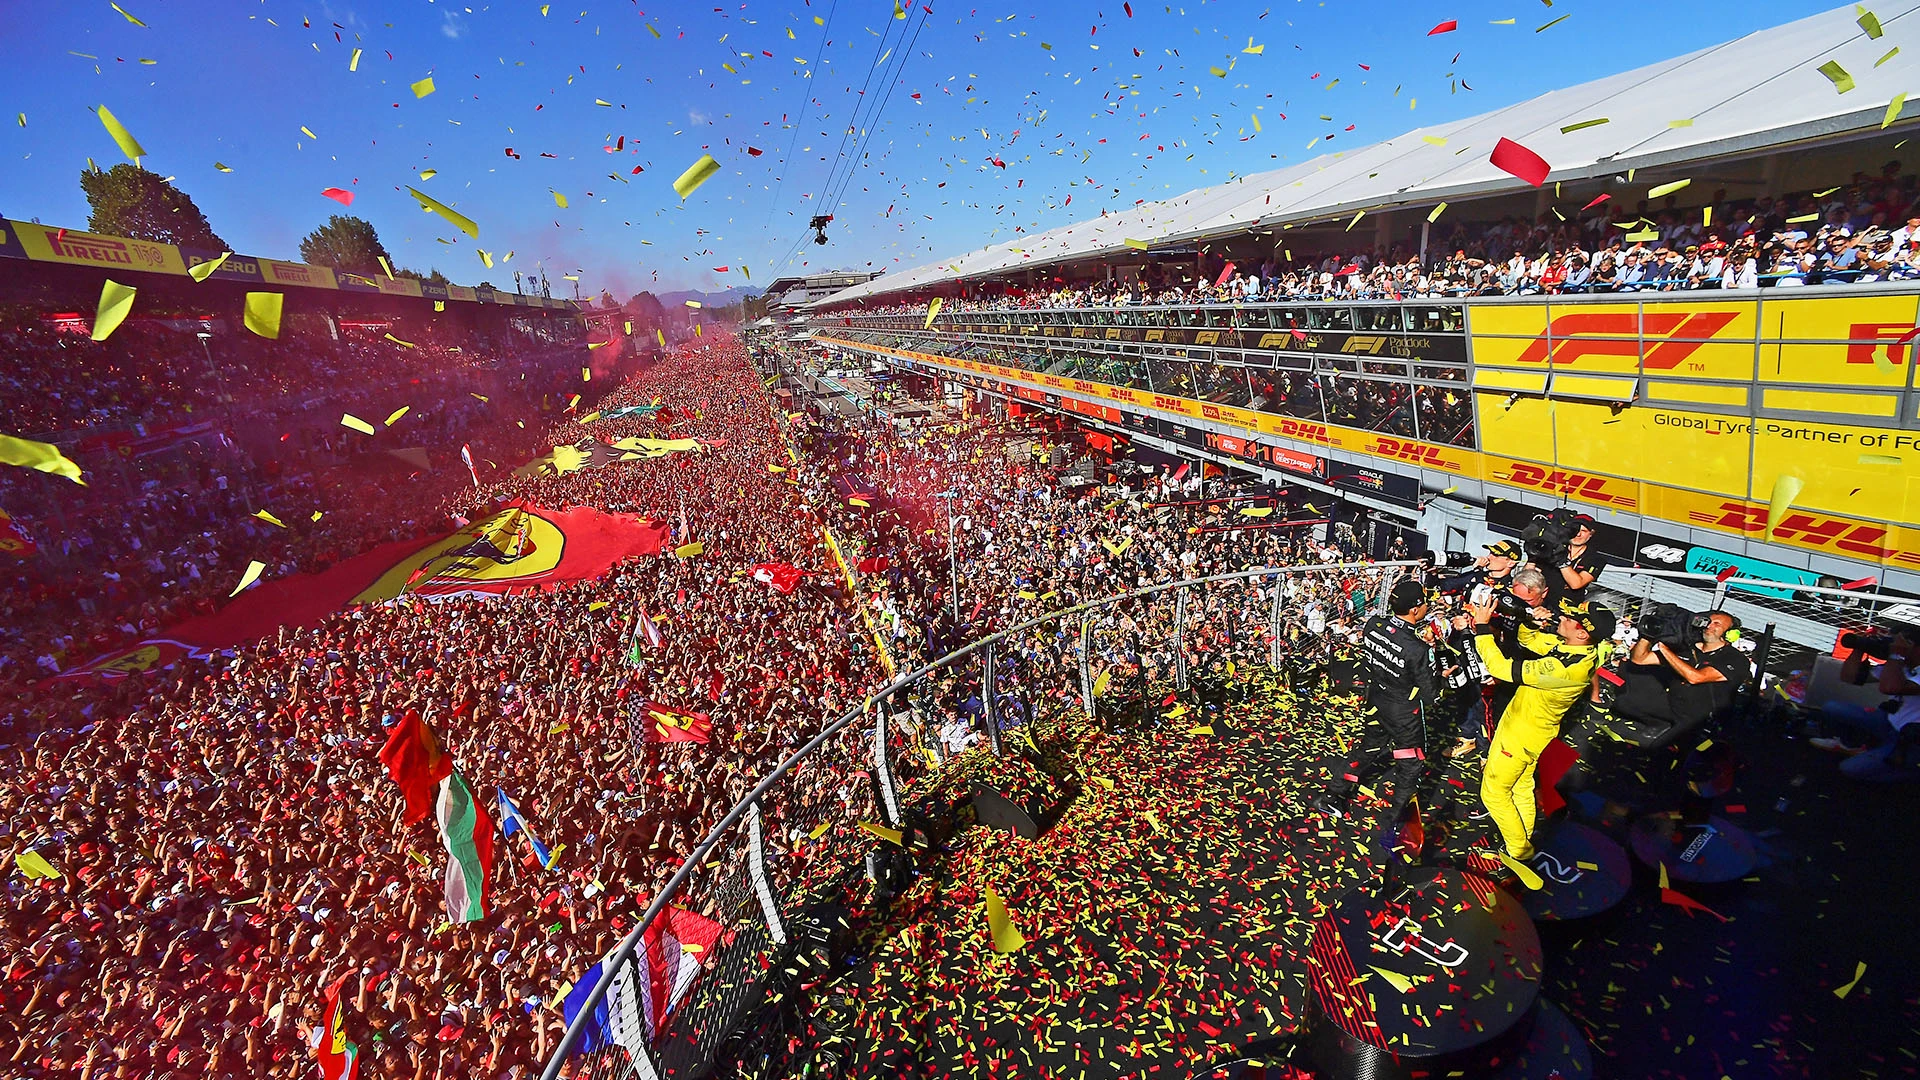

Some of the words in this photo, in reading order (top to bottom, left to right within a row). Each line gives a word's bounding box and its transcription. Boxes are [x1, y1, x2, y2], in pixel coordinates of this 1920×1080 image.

[45, 231, 132, 264] PIRELLI
[208, 258, 256, 274] ERO
[271, 263, 311, 283] PIRELLI
[1195, 331, 1220, 345] F1
[1258, 333, 1291, 349] F1
[1340, 335, 1387, 354] F1
[1389, 337, 1430, 348] Paddock
[1516, 312, 1741, 369] F1
[1687, 363, 1705, 372] TM
[1074, 381, 1098, 395] DHL
[1110, 388, 1136, 402] DHL
[1154, 396, 1185, 412] DHL
[1281, 420, 1331, 443] DHL
[1654, 413, 1709, 430] Global
[1714, 419, 1760, 435] Tyre
[1767, 424, 1854, 445] Partner
[1860, 434, 1889, 448] of
[1376, 438, 1446, 467] DHL
[1358, 469, 1384, 480] ORACLE
[1510, 463, 1614, 502] DHL
[1716, 502, 1899, 558] DHL
[1640, 543, 1687, 564] 44
[1698, 555, 1731, 568] LEWIS
[1462, 639, 1482, 680] FERRARI
